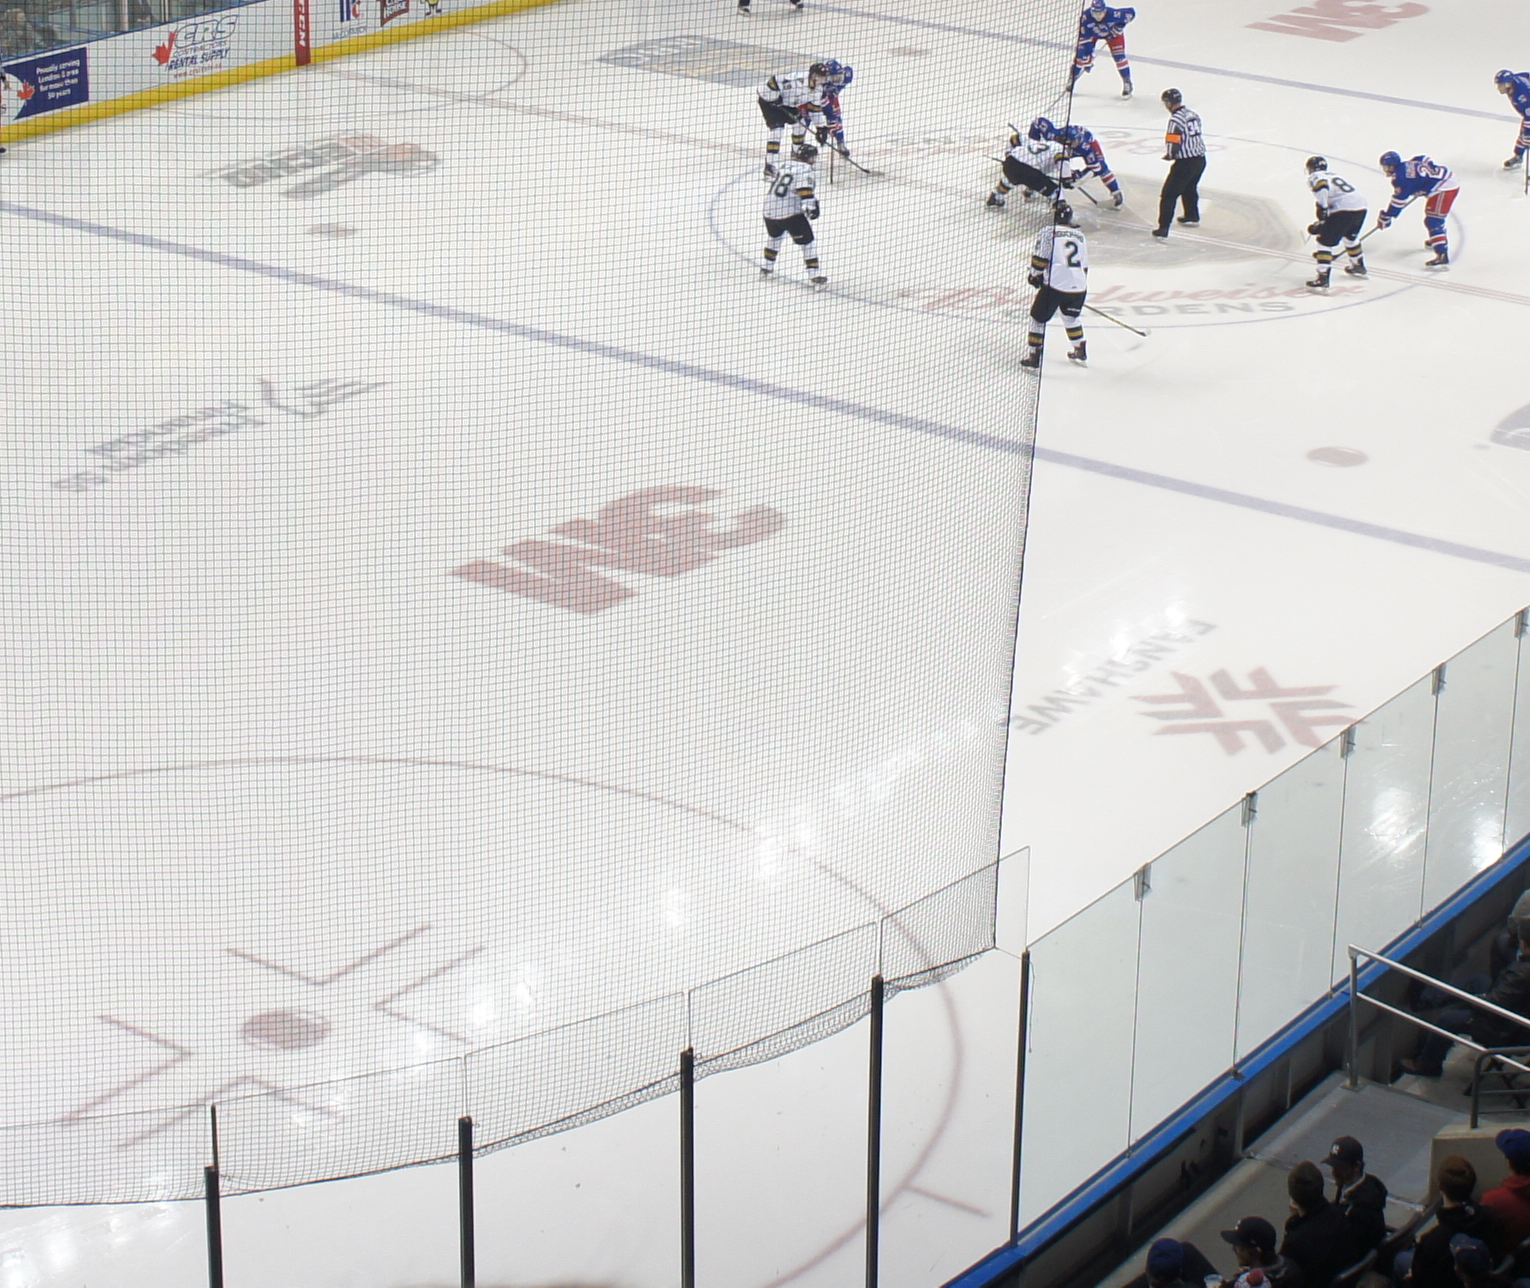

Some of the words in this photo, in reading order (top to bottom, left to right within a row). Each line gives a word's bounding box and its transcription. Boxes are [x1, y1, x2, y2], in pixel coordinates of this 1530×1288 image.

[1186, 118, 1201, 136] 34
[1331, 176, 1356, 194] 8
[1065, 241, 1082, 268] 2
